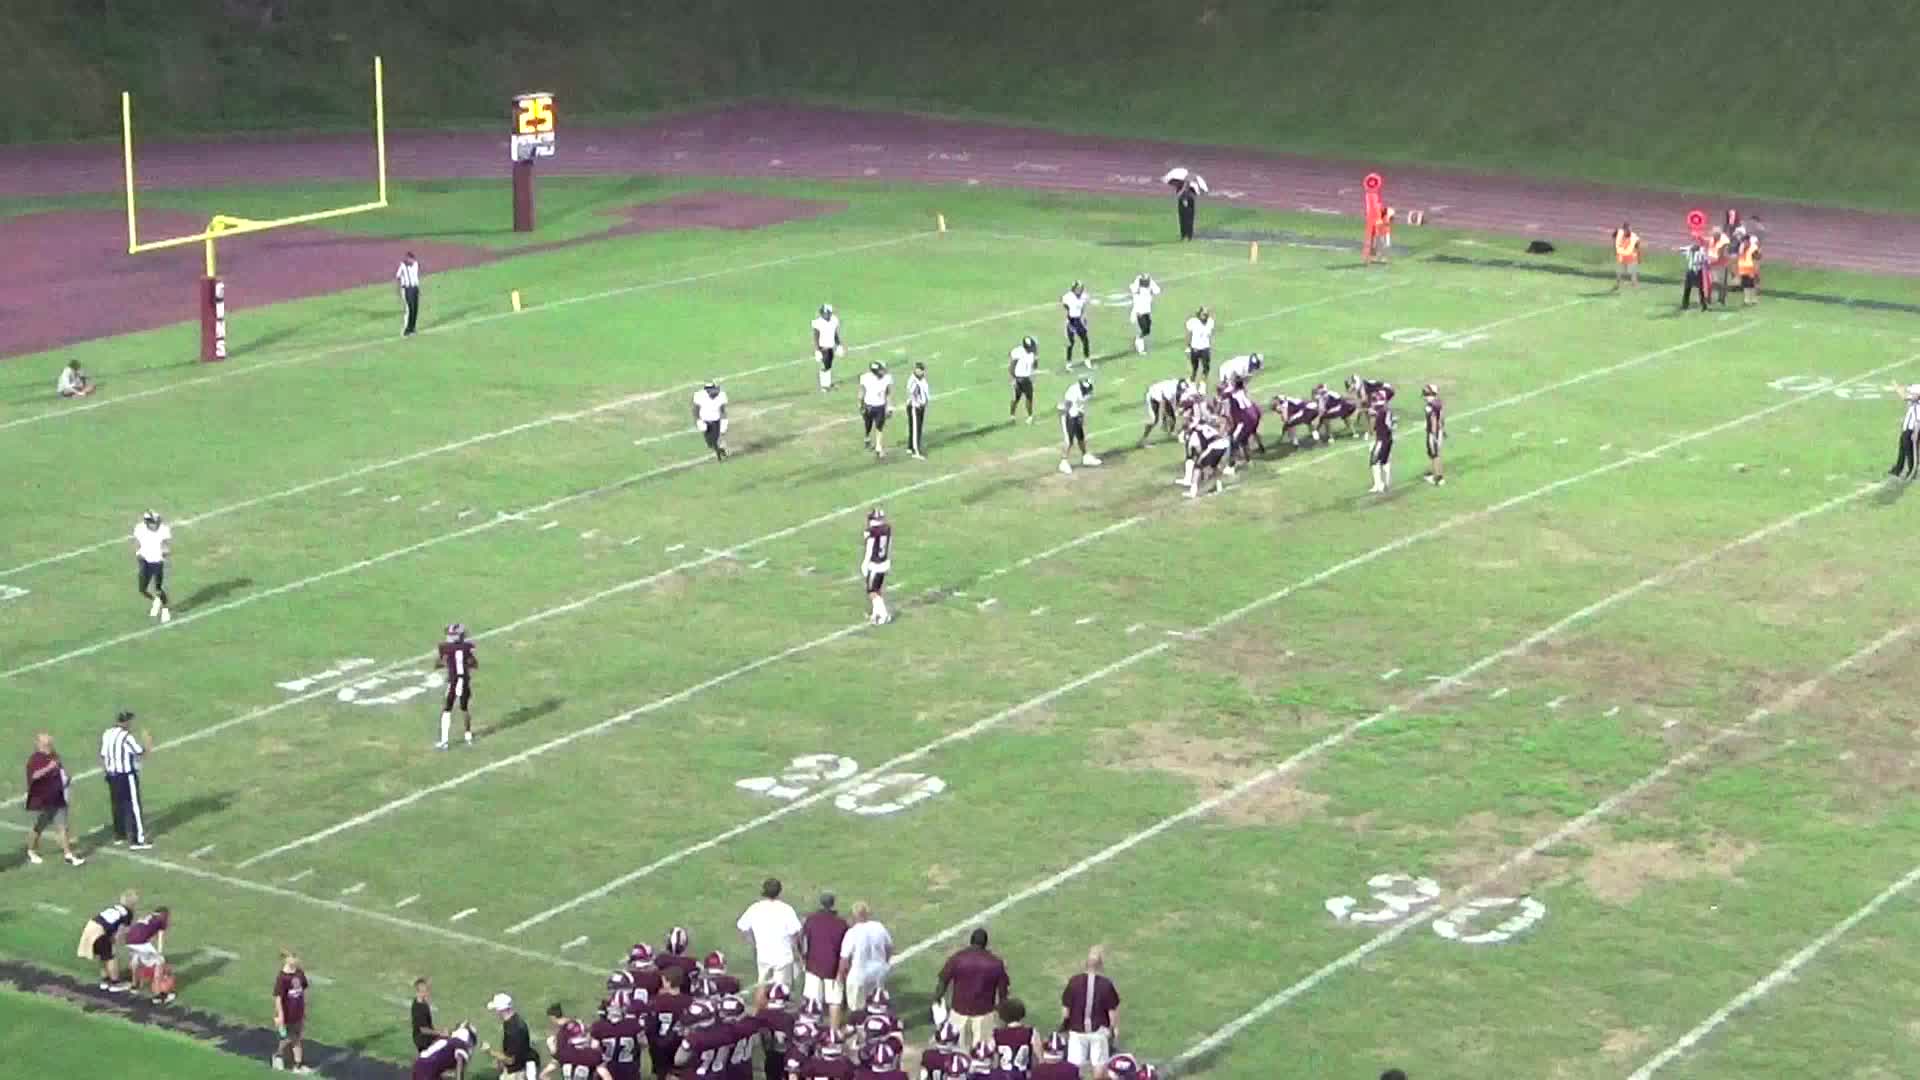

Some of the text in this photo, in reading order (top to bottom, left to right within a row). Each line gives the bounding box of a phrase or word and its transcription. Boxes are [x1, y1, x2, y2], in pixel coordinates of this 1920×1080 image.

[519, 98, 552, 133] 25
[455, 650, 464, 674] 1
[1325, 873, 1546, 943] 30
[602, 1037, 634, 1062] 72
[998, 1045, 1030, 1072] 24
